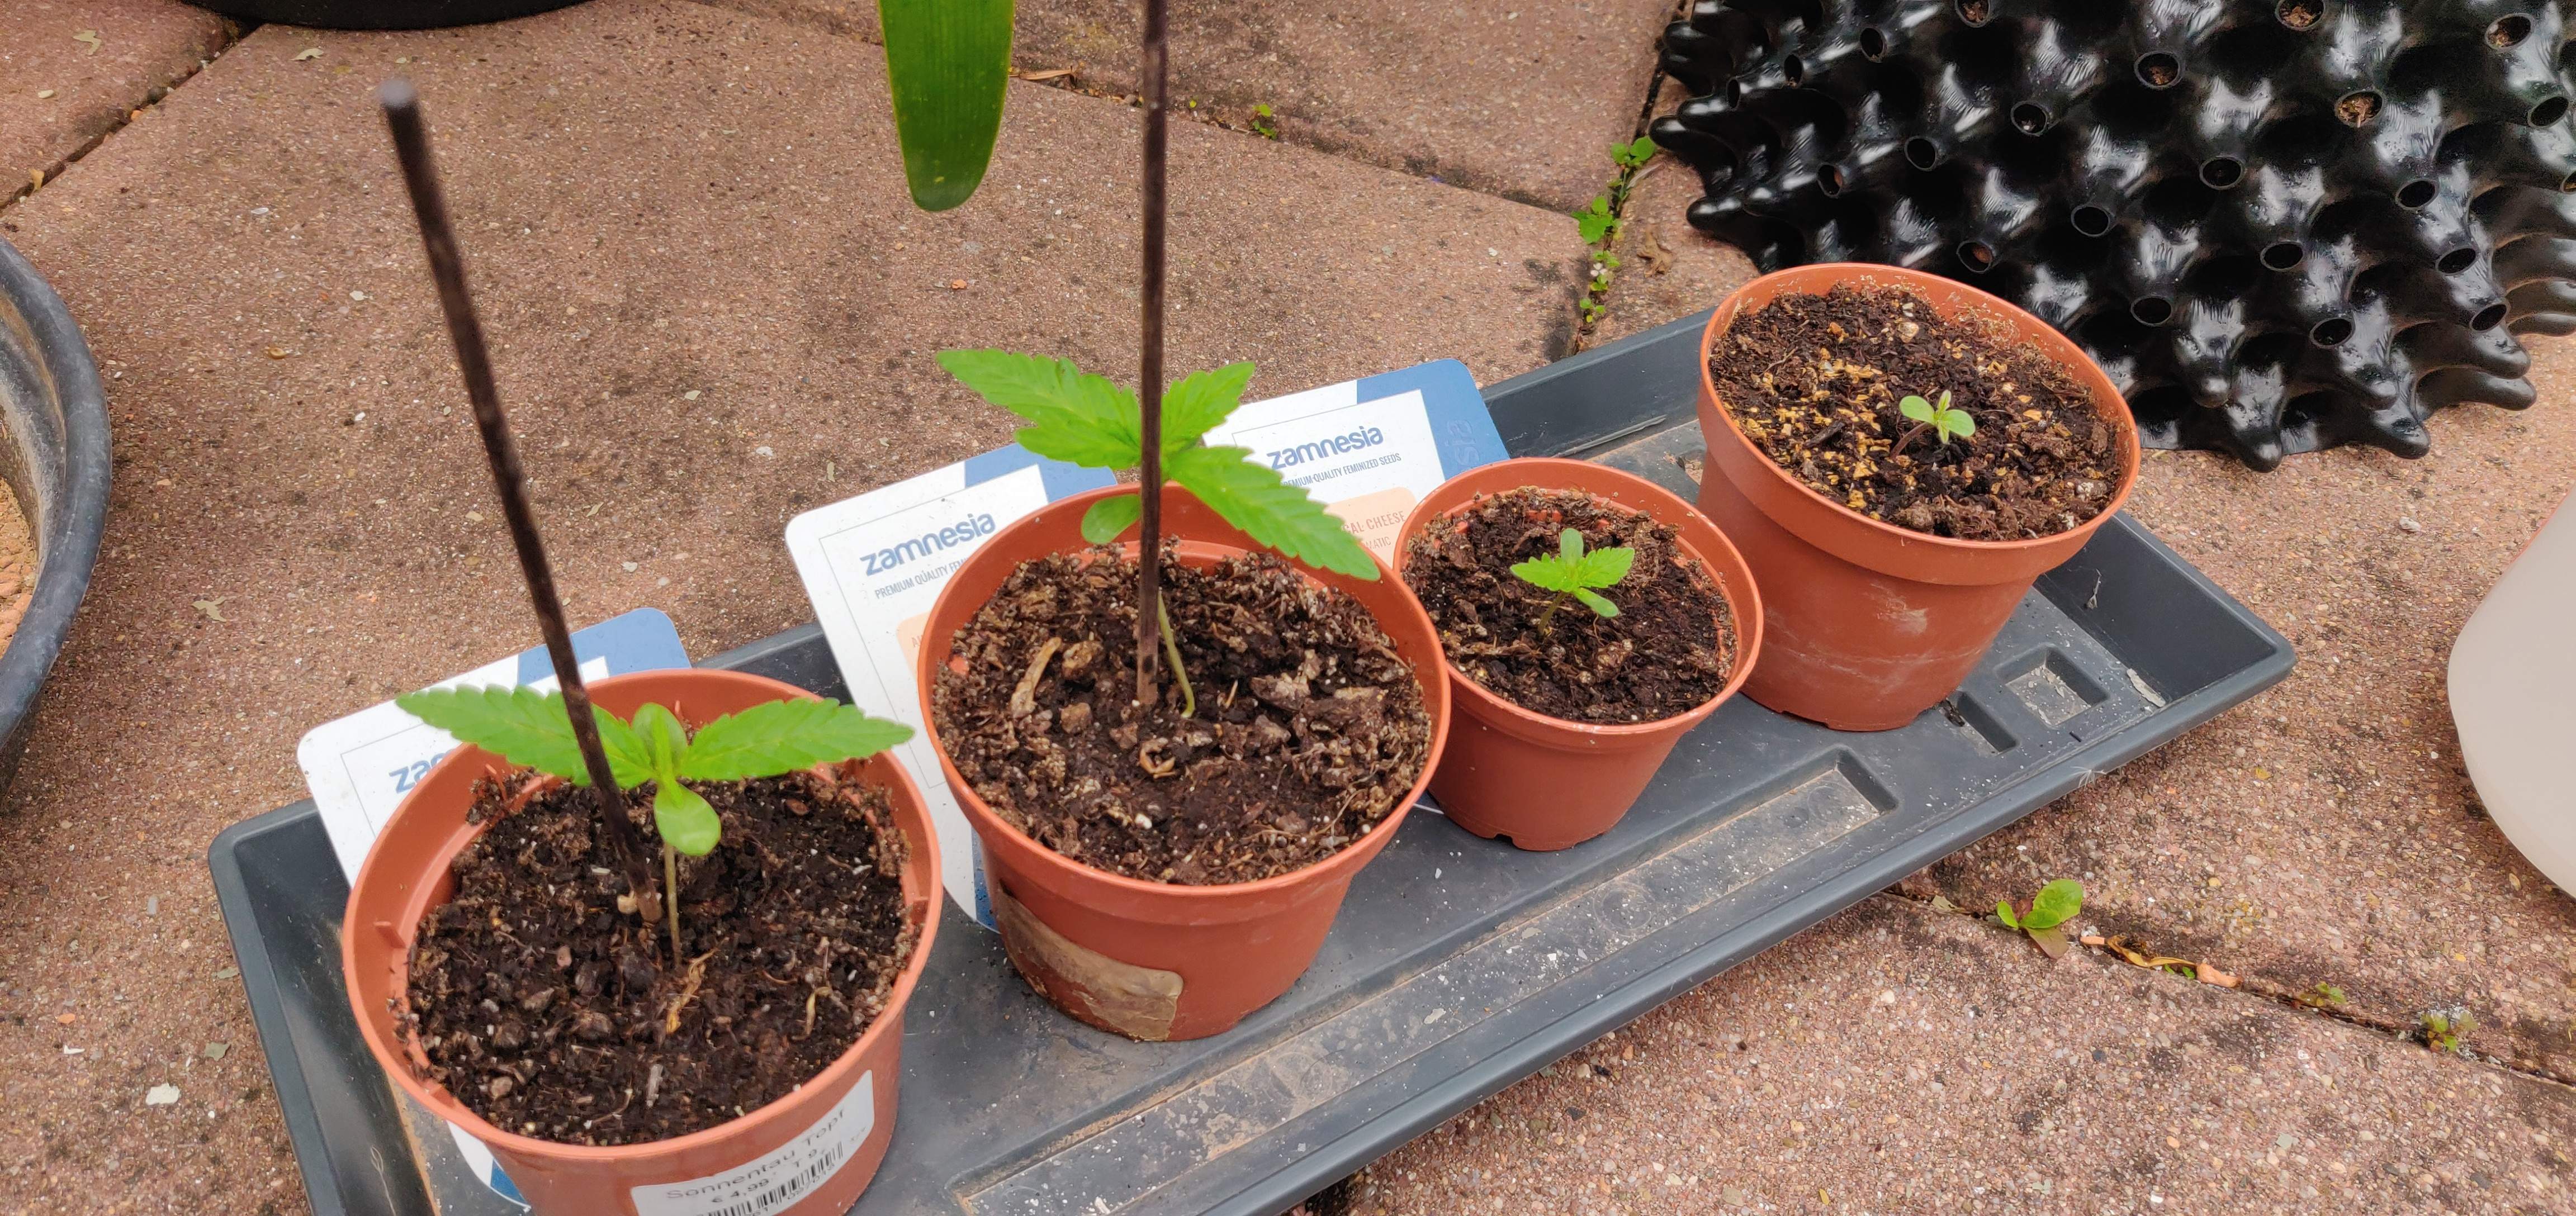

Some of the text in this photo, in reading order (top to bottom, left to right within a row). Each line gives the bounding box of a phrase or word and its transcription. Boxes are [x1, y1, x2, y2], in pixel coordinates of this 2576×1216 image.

[1267, 425, 1384, 470] zamnesia
[1313, 467, 1343, 482] QUALITY
[1343, 458, 1380, 476] FEMINIZED
[1379, 453, 1402, 466] SEEDS
[1366, 510, 1407, 530] CHEESE
[859, 512, 996, 577] zamnesia
[874, 578, 915, 600] PREMIUM
[915, 565, 949, 585] QUALITY
[667, 1150, 795, 1200] Sonnentau
[802, 1105, 845, 1146] Topf
